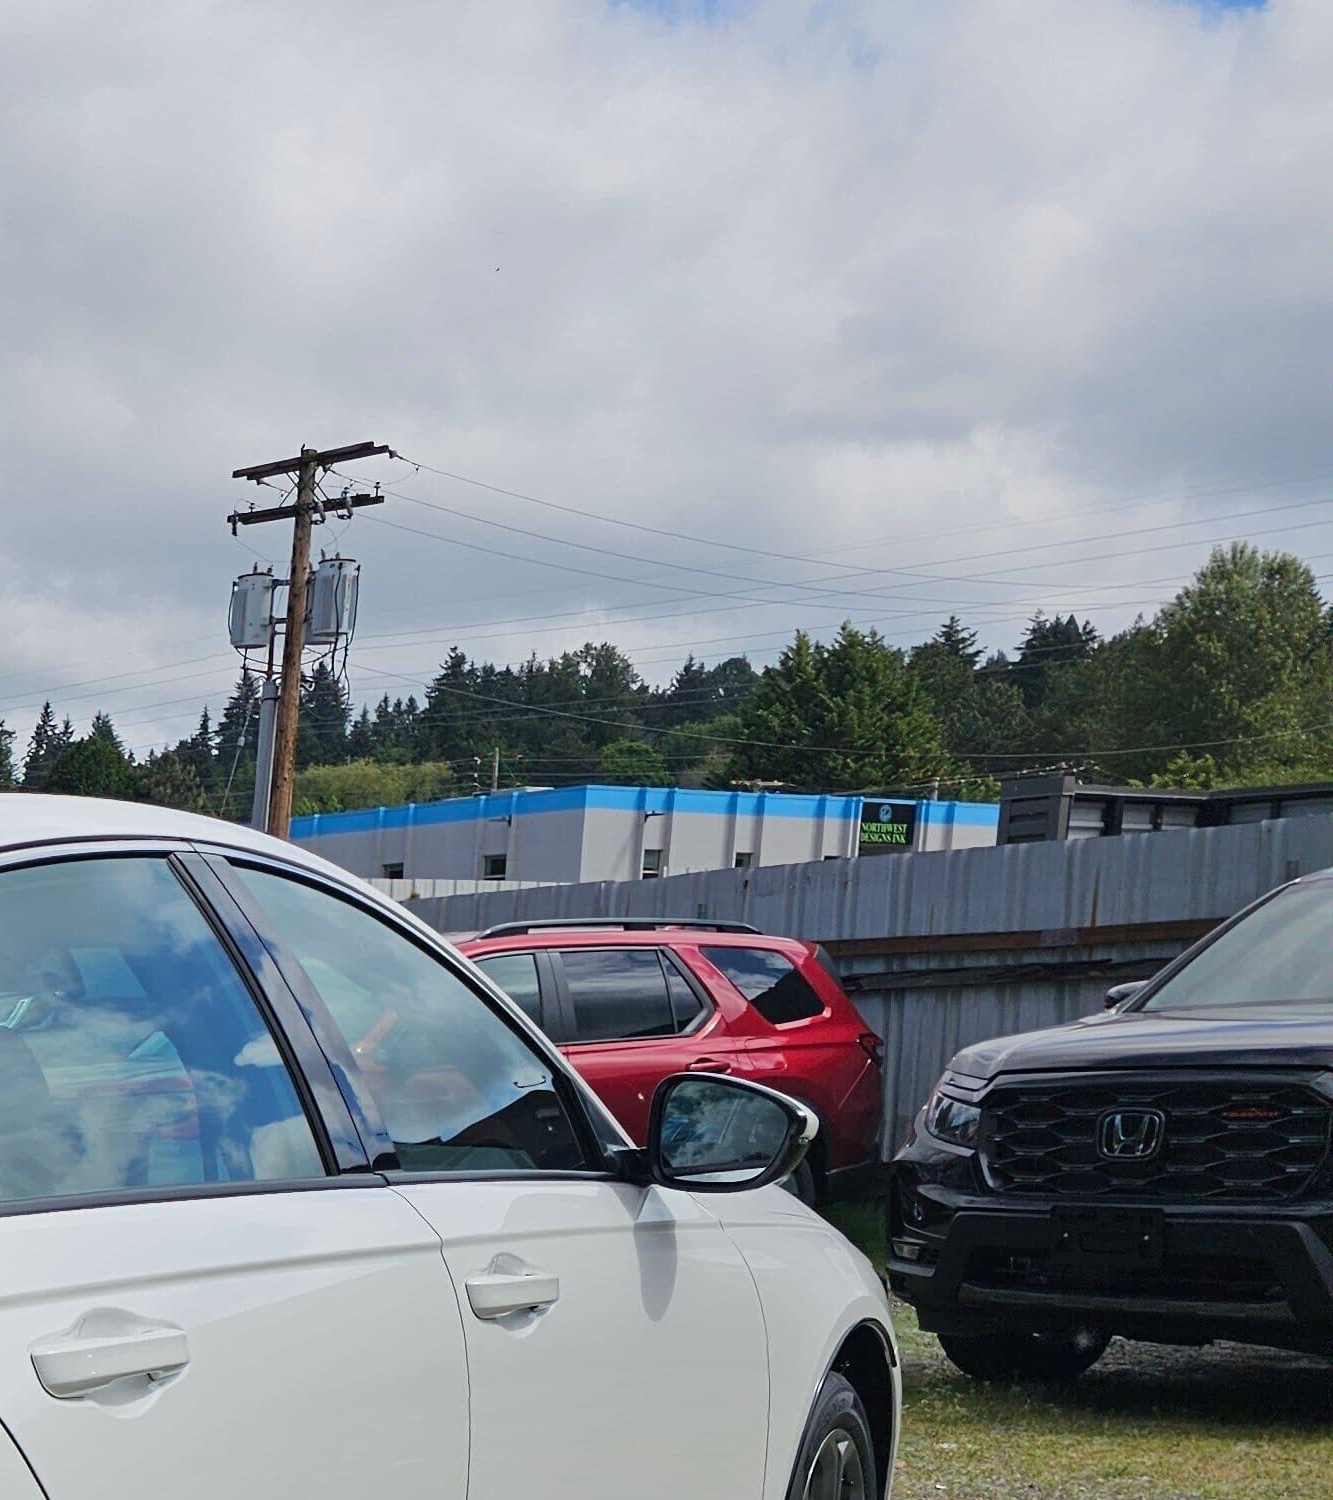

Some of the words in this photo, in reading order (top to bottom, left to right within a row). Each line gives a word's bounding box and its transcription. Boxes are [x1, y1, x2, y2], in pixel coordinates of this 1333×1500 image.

[861, 823, 908, 834] NORTHWEST
[860, 833, 892, 842] DESIGNS
[893, 834, 906, 844] INK
